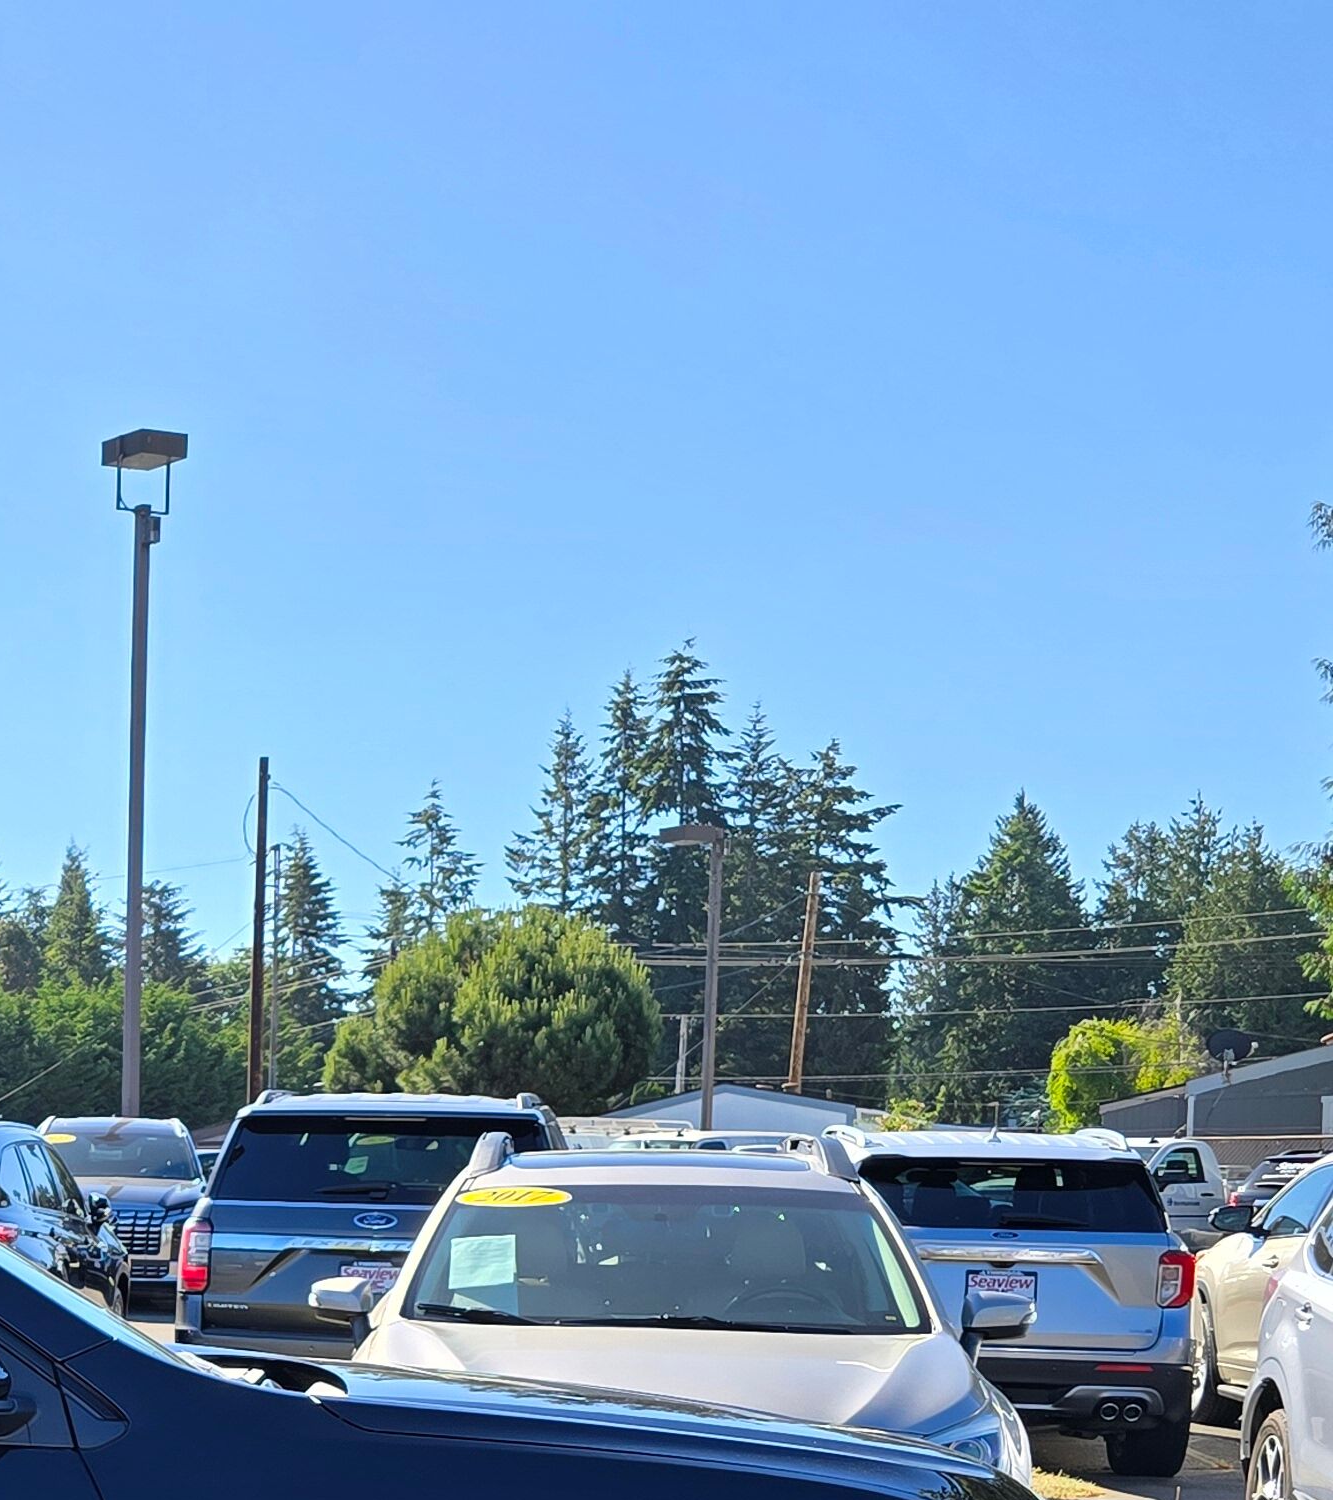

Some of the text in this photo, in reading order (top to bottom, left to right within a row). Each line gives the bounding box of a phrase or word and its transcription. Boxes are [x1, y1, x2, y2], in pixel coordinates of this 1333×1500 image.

[473, 1190, 556, 1202] 2017
[302, 1240, 413, 1249] EXPEDIT
[343, 1266, 400, 1280] Seaview
[968, 1275, 1034, 1289] Seaview
